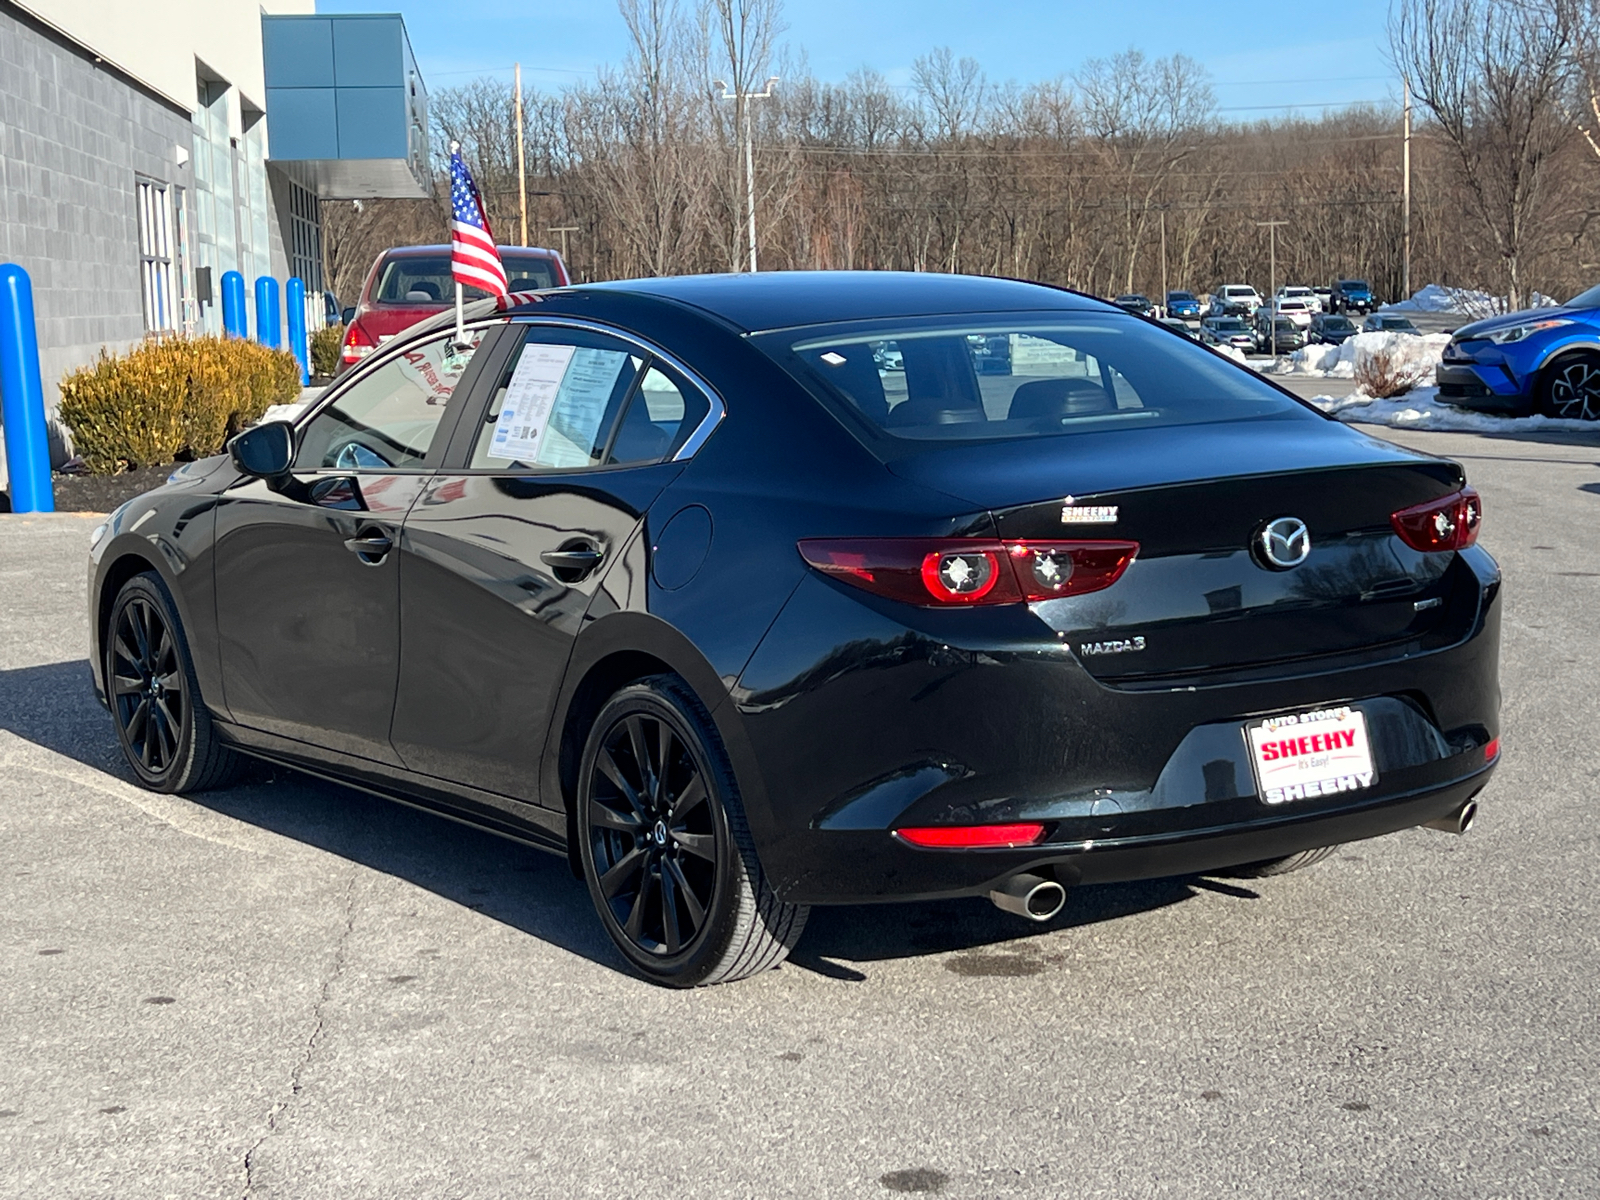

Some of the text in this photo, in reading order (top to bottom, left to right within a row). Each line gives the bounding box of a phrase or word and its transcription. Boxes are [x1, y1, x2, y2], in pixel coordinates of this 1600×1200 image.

[1261, 715, 1298, 730] AUTO
[1260, 728, 1356, 761] SHEEHY
[1298, 755, 1330, 770] It's Easy!
[1265, 771, 1374, 804] SHEEHY
